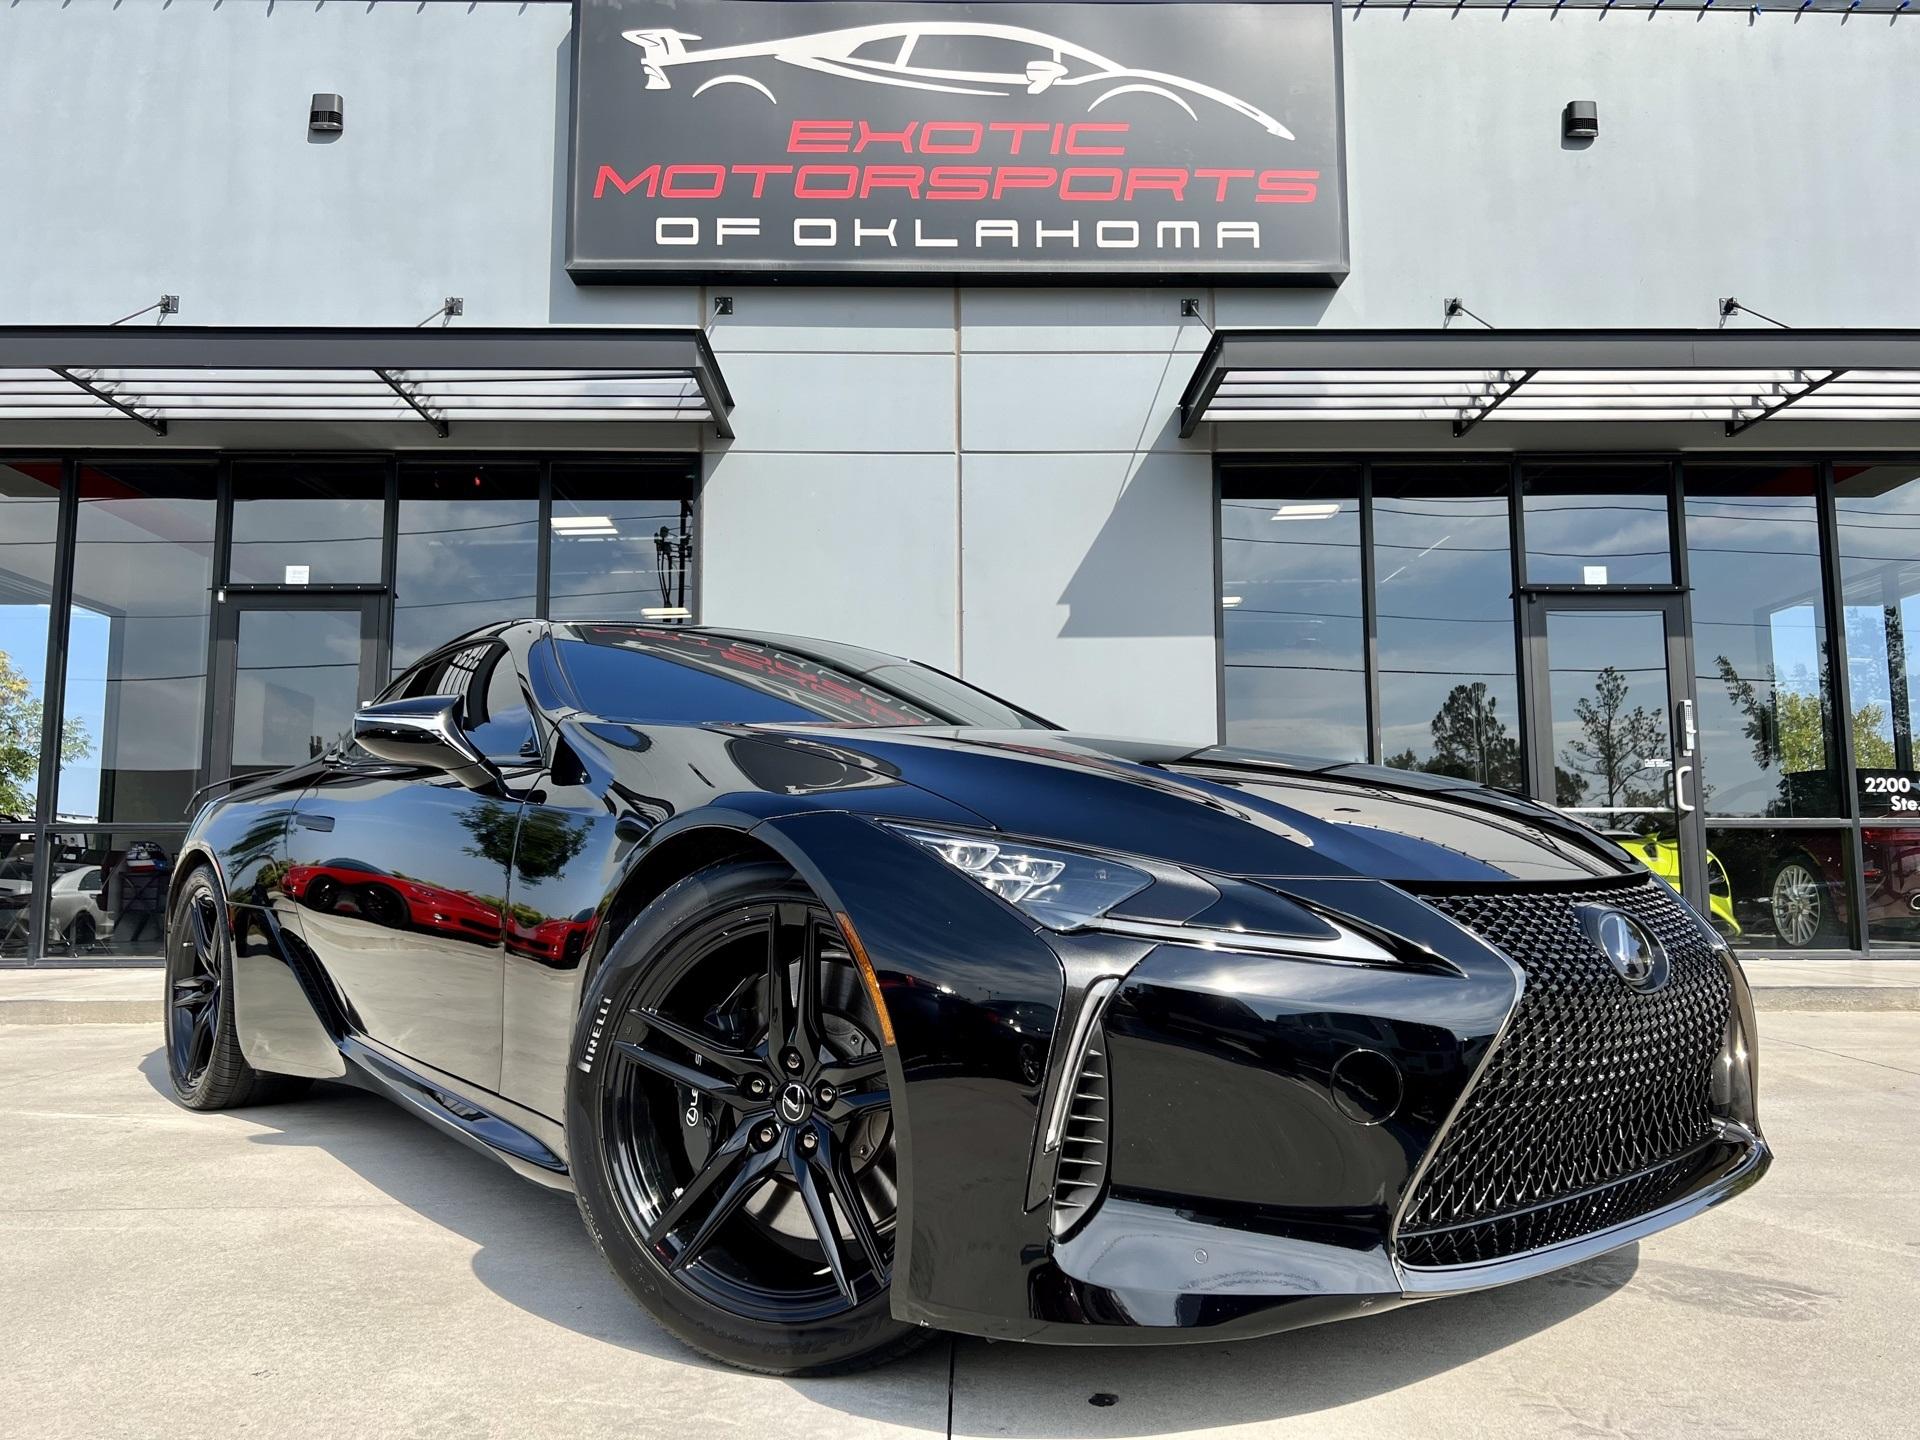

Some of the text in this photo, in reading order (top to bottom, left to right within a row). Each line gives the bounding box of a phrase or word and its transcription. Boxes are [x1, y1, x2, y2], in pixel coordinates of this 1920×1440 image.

[787, 120, 1130, 155] EXOTIC
[593, 163, 1320, 203] MOTORSPORTS
[655, 217, 1261, 249] OF OKLAHOMA
[1864, 777, 1911, 793] 2200
